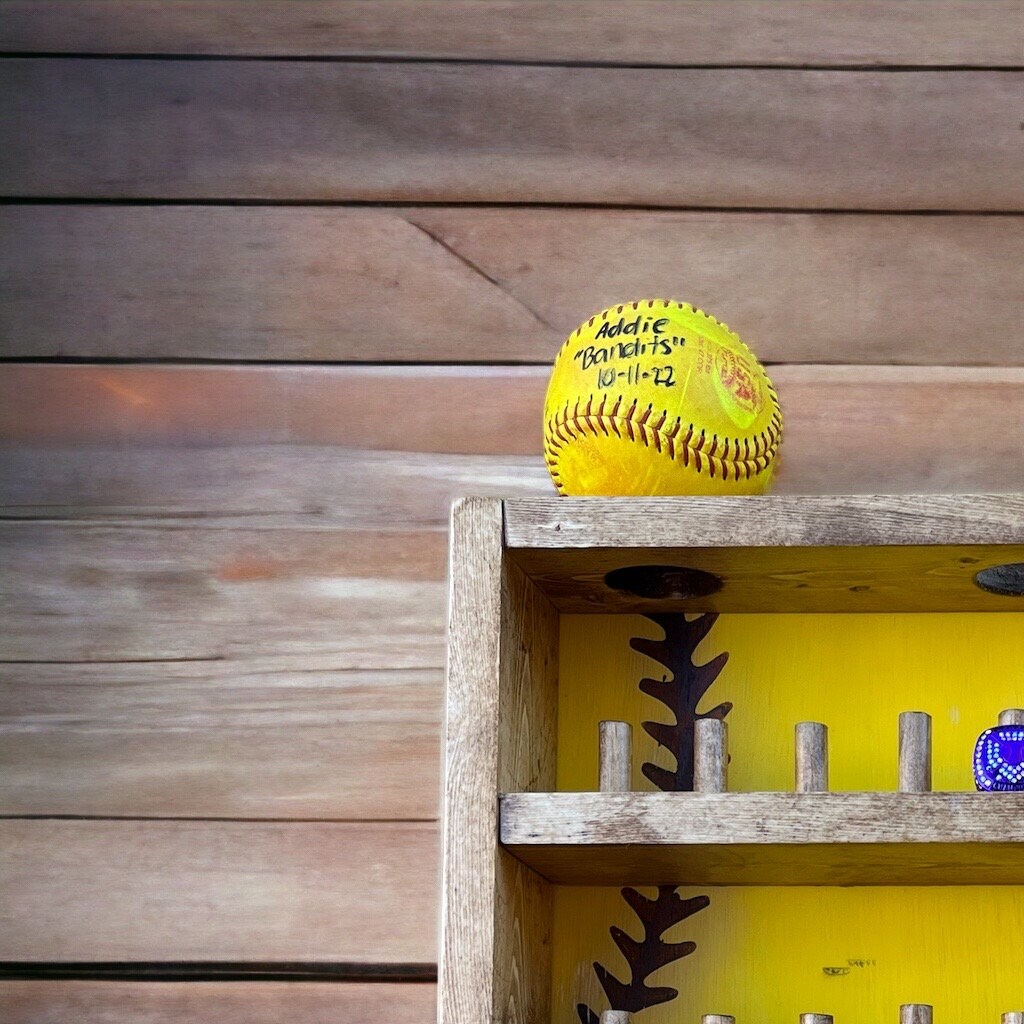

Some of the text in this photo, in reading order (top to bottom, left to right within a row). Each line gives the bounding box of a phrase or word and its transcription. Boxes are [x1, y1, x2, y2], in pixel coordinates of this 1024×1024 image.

[595, 315, 670, 341] Addie
[574, 334, 686, 370] "Bandits"
[597, 363, 677, 389] 10-11-22
